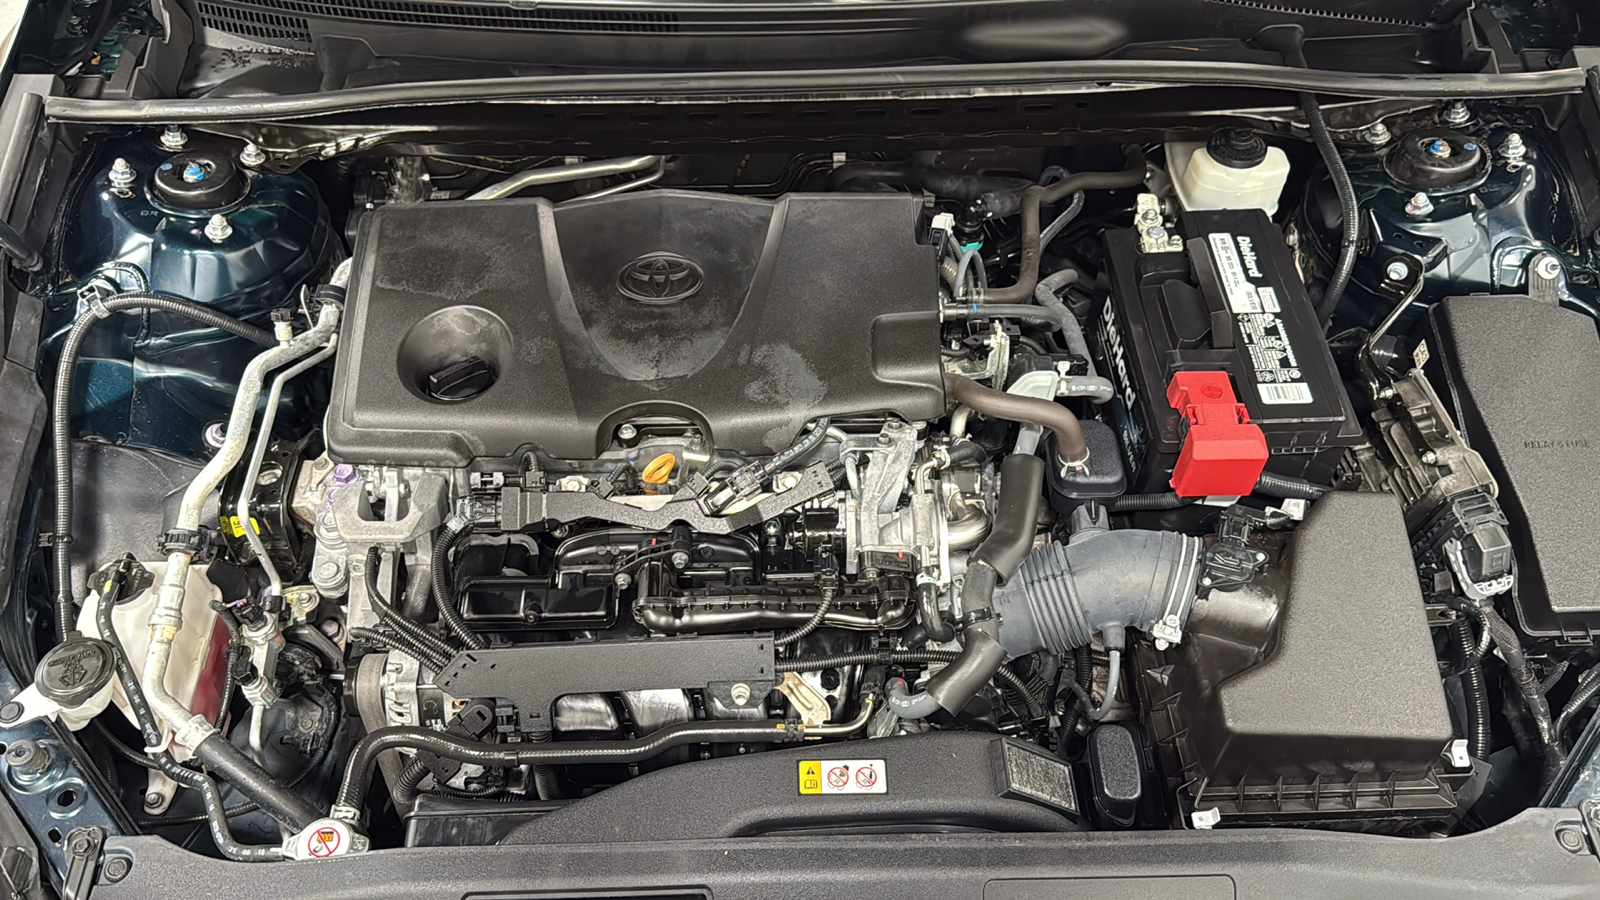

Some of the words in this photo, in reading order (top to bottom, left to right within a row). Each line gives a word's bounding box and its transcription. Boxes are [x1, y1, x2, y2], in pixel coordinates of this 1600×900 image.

[1236, 235, 1263, 278] DieHard
[1245, 291, 1257, 310] SILVER
[1103, 295, 1136, 412] DieHard
[1122, 430, 1136, 473] SILVER
